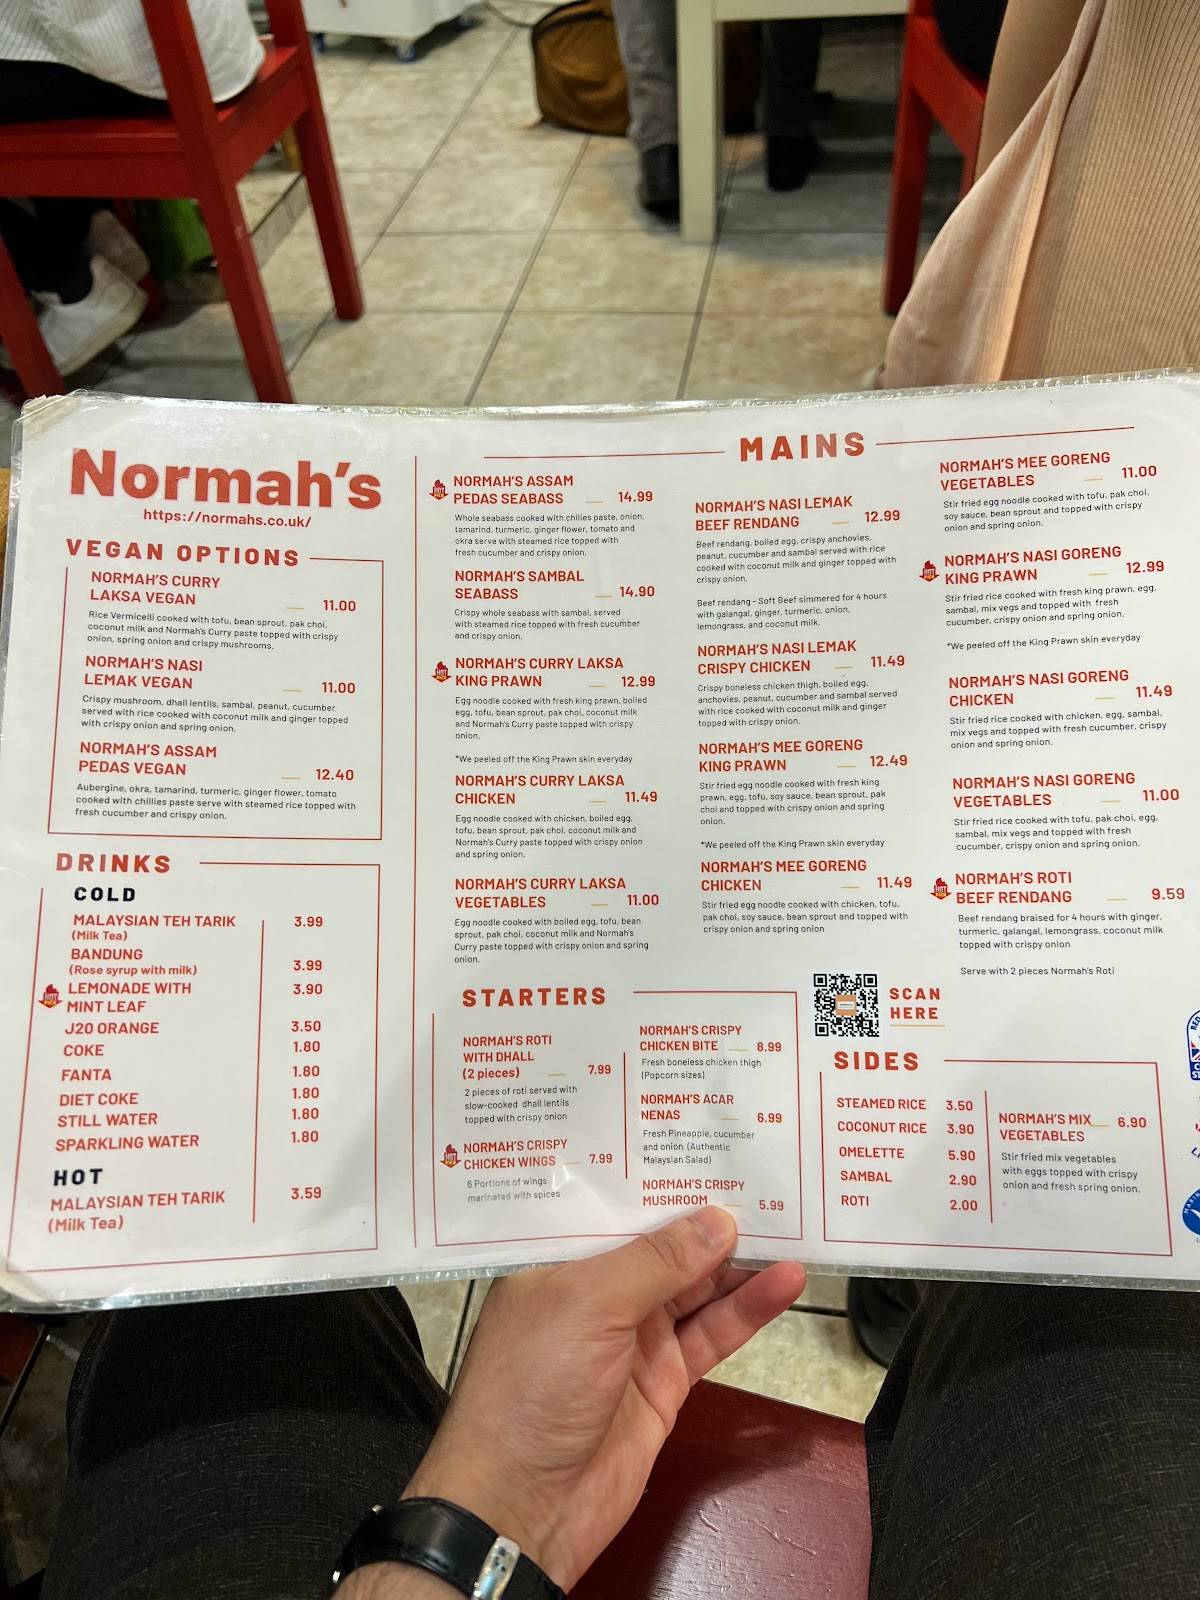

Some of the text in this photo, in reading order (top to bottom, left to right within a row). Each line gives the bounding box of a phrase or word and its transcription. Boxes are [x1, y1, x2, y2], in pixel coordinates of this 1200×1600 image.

[740, 432, 864, 462] MAINS
[1122, 465, 1157, 478] 11.00
[70, 449, 381, 510] Normah's
[454, 475, 573, 487] NORMAH'S ASSAM
[454, 493, 563, 504] PEDAS SEABASS
[618, 491, 653, 502] 14.99
[696, 496, 852, 513] NORMAH'S NASI LEMAK
[144, 508, 311, 528] https://normahs.co.uk/
[864, 509, 900, 523] 12.99
[696, 516, 799, 531] BEEF RENDANG
[944, 524, 968, 532] onion
[970, 522, 986, 531] and
[988, 521, 1015, 530] spring
[454, 537, 473, 545] okra
[498, 537, 516, 545] with
[518, 536, 552, 545] steamed
[554, 537, 569, 545] rice
[571, 536, 599, 546] topped
[66, 538, 298, 567] VEGAN OPTIONS
[945, 546, 1121, 567] NORMAH'S NASI GORENG
[696, 556, 896, 572] cooked with coconut milk and ginger topped with
[1126, 560, 1164, 574] 12.99
[92, 571, 220, 588] NORMAH'S CURRY
[90, 589, 195, 605] LAKSA VEGAN
[323, 599, 356, 612] 11.00
[88, 624, 125, 634] coconut
[126, 624, 145, 636] milk
[147, 626, 164, 638] and
[165, 626, 206, 636] Normah's
[208, 628, 232, 638] Curry
[234, 630, 258, 638] paste
[260, 631, 290, 640] topped
[312, 632, 338, 642] crispy
[698, 660, 810, 675] CRISPY CHICKEN
[870, 655, 905, 667] 11.49
[455, 675, 542, 687] KING PRAWN
[621, 676, 655, 687] 12.99
[474, 755, 501, 764] peeled
[503, 755, 515, 763] off
[516, 755, 530, 763] the
[532, 755, 551, 765] King
[552, 755, 577, 763] Prawn
[578, 755, 595, 763] skin
[597, 755, 632, 764] everyday
[870, 754, 907, 767] 12.49
[78, 760, 186, 775] PEDAS VEGAN
[316, 768, 354, 781] 12.40
[700, 778, 879, 791] Stir fried egg noodle cooked with fresh king
[455, 793, 515, 804] CHICKEN
[625, 791, 657, 803] 11.49
[56, 853, 170, 873] DRINKS
[74, 887, 135, 902] COLD
[627, 894, 659, 906] 11.00
[956, 891, 1072, 904] BEEF RENDANG
[1152, 888, 1185, 900] 9.59
[455, 896, 546, 908] VEGETABLES
[74, 914, 235, 927] MALAYSIAN TEH TARIK
[294, 916, 323, 927] 3.99
[72, 930, 127, 941] (Milk Tea)
[959, 940, 991, 950] topped
[1015, 940, 1043, 950] crispy
[1044, 940, 1070, 948] onion
[71, 948, 143, 960] BANDUNG
[69, 964, 197, 977] (Rose syrup with milk)
[293, 960, 322, 971] 3.99
[960, 966, 1114, 976] Serve with 2 pieces Normah's Roti
[462, 987, 605, 1007] STARTERS
[890, 988, 940, 1000] SCAN
[890, 1007, 938, 1020] HERE
[294, 1041, 320, 1052] 1.80
[463, 1034, 551, 1047] NORMAH'S ROTI
[640, 1040, 718, 1051] CHICKEN BITE
[757, 1041, 781, 1052] 8.99
[64, 1044, 104, 1057] COKE
[463, 1051, 534, 1063] WITH DHALL
[642, 1058, 761, 1068] Fresh boneless chicken thigh
[834, 1051, 918, 1071] SIDES
[462, 1066, 520, 1081] (2 pieces)
[588, 1064, 611, 1075] 7.99
[464, 1085, 577, 1098] 2 pieces of roti served with
[837, 1097, 926, 1110] STEAMED RICE
[946, 1100, 973, 1111] 3.50
[999, 1113, 1092, 1126] NORMAH'S MIX
[1118, 1116, 1146, 1128] 6.90
[464, 1155, 556, 1170] CHICKEN WINGS
[1001, 1152, 1116, 1165] Stir fried mix vegetables
[53, 1168, 103, 1186] HOT
[291, 1186, 321, 1200] 3.59
[643, 1194, 707, 1206] MUSHROOM
[759, 1200, 784, 1211] 5.99
[841, 1195, 869, 1206] ROTI
[950, 1199, 978, 1211] 2.00
